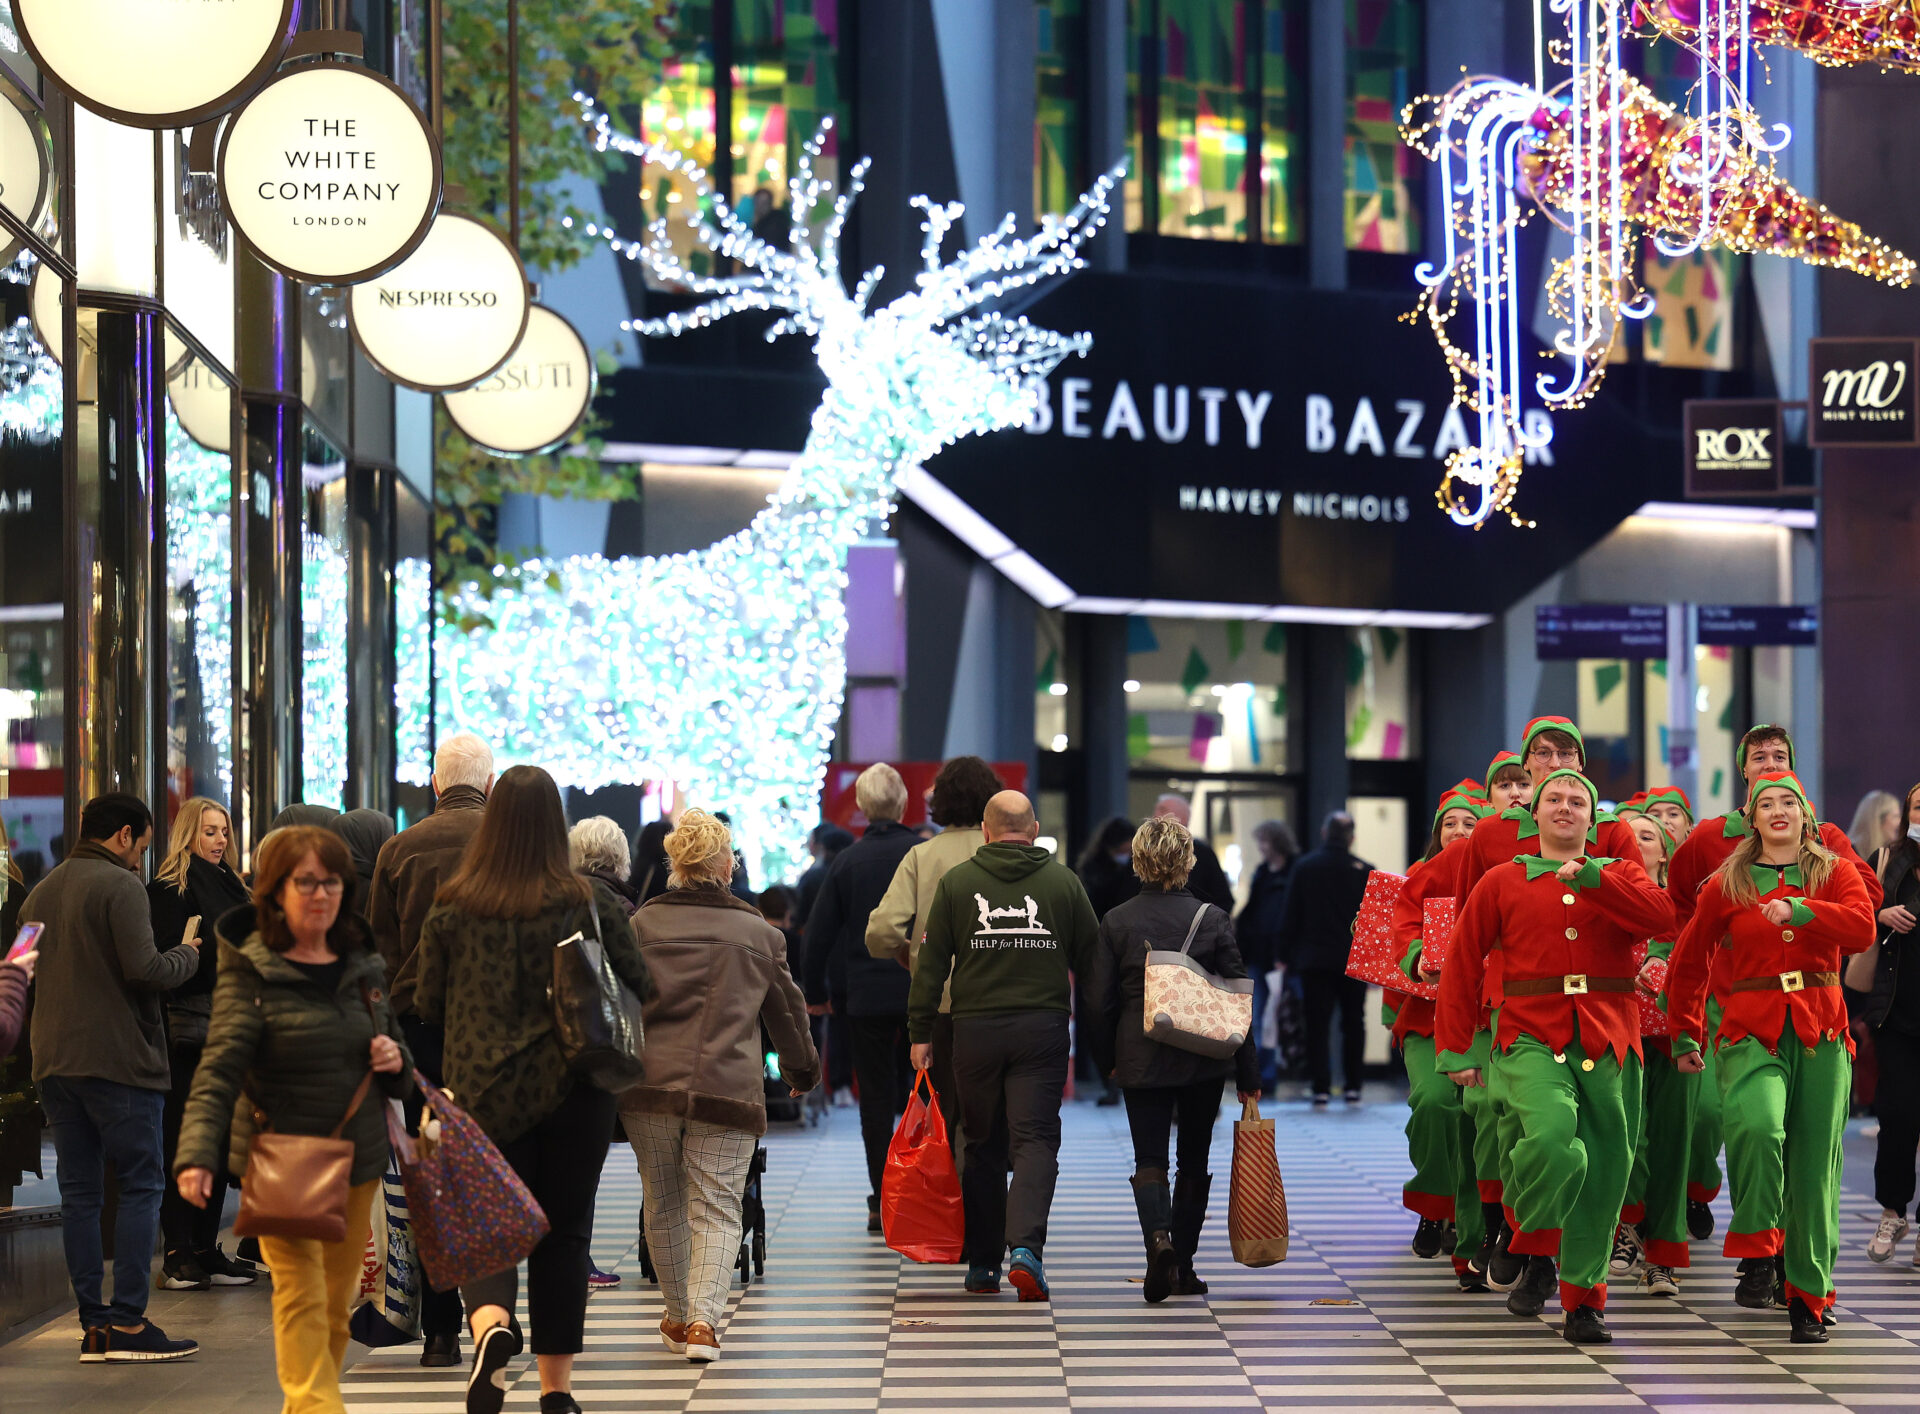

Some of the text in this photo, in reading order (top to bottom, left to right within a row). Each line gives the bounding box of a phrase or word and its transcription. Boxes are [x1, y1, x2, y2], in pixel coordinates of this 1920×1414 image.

[303, 118, 356, 137] THE
[284, 151, 376, 170] WHITE
[258, 181, 400, 201] COMPANY
[293, 216, 366, 226] LONDON
[379, 288, 497, 309] NESPRESSO
[1822, 410, 1905, 421] MINT VELVET
[1695, 427, 1772, 461] ROX
[1179, 485, 1410, 523] HARVEY NICHOLS
[970, 938, 1057, 950] HELP for HEROES
